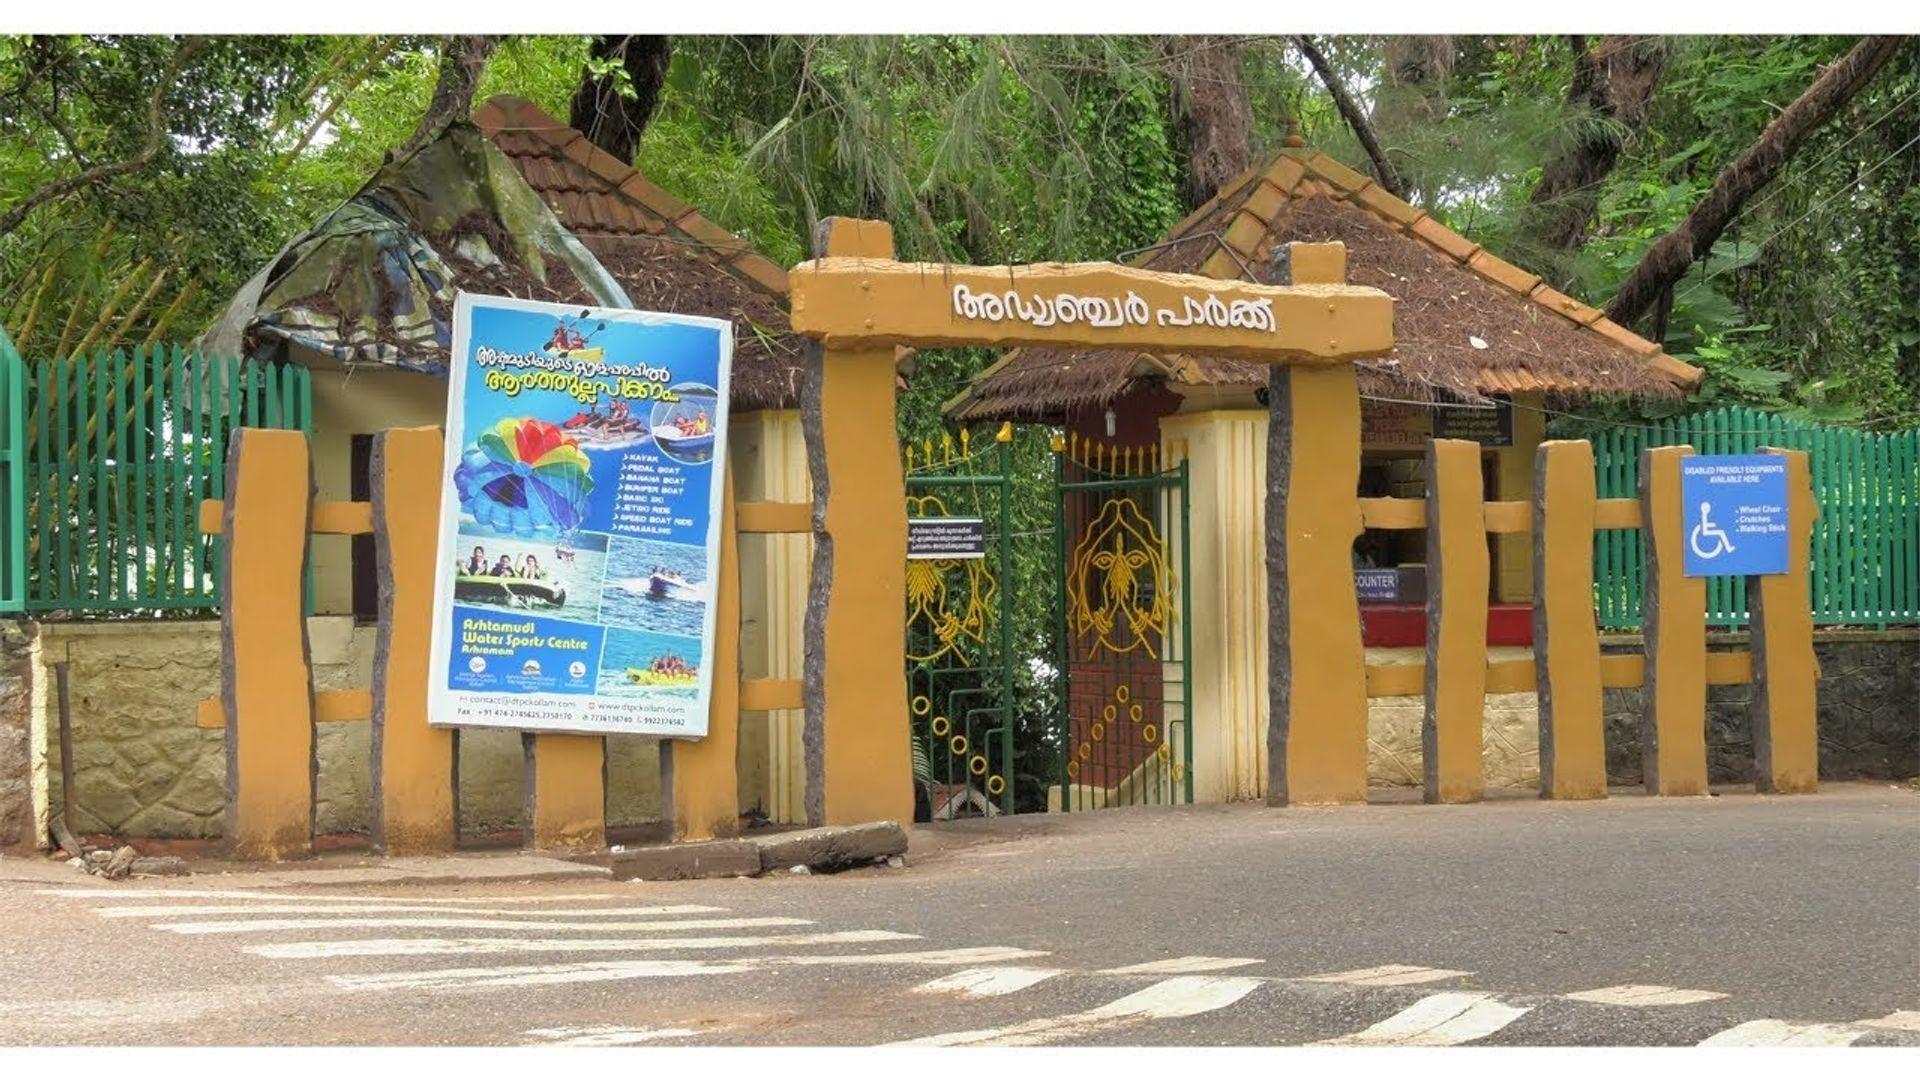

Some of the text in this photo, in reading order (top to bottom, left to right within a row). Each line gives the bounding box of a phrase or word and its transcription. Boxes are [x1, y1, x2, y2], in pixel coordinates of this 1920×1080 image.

[629, 454, 658, 462] KAYAK
[627, 464, 680, 474] PEDAL BOAT
[1684, 467, 1715, 475] DISABLED
[1716, 466, 1744, 474] FRIENDLY
[625, 474, 685, 485] BANANA BOAT
[1710, 475, 1760, 483] AVAILABLE HERE
[624, 484, 684, 495] BUMPER BOAT
[623, 494, 648, 502] BASIC
[652, 506, 671, 514] RIDE
[1762, 505, 1780, 513] Chair
[620, 514, 694, 526] SPEED BOAT RIDE
[1739, 524, 1786, 534] Walking Stick
[463, 618, 535, 634] Ashtamudi
[462, 632, 589, 650] Water Sports Centre
[462, 645, 514, 656] Ashramam
